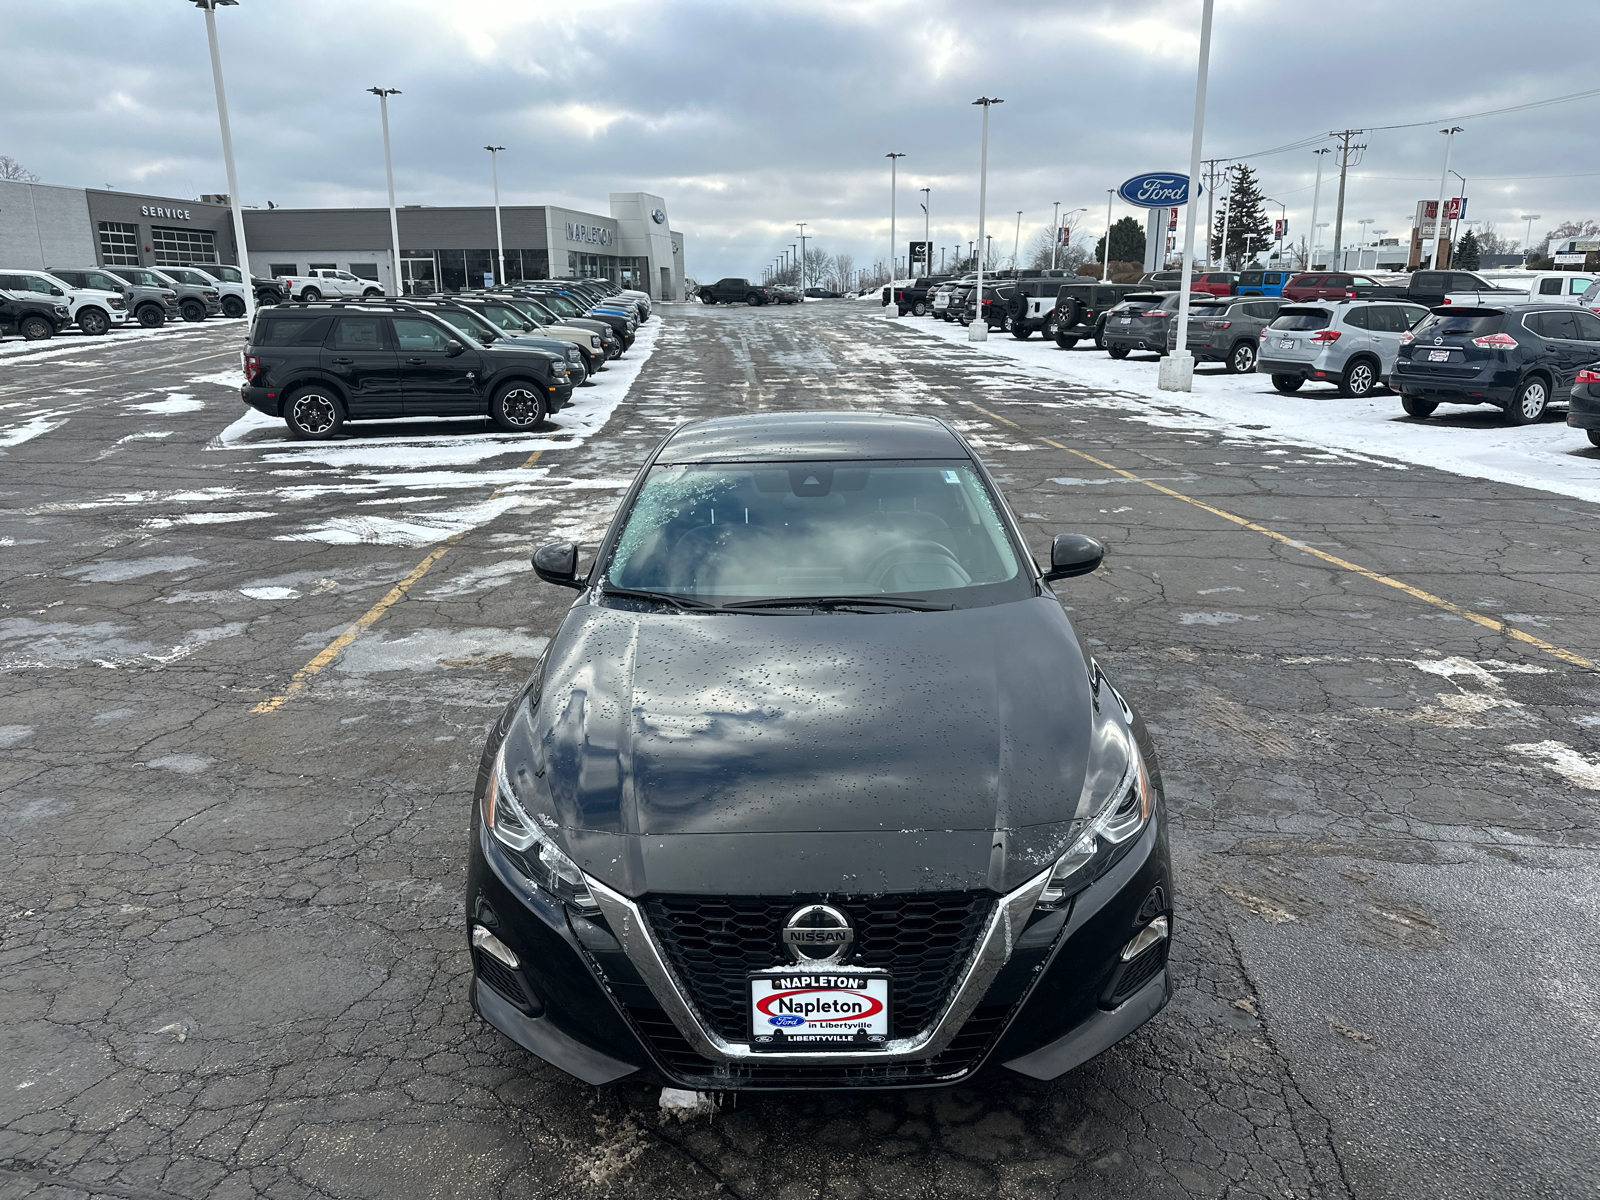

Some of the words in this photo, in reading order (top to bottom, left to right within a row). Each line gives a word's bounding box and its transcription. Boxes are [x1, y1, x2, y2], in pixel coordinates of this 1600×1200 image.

[1137, 178, 1187, 200] Ford
[142, 205, 191, 220] SERVICE
[566, 221, 613, 246] NAPLETON
[790, 931, 846, 941] NISSAN
[780, 976, 859, 988] NAPLETON
[778, 998, 863, 1016] Napleton
[775, 1016, 798, 1026] Ford
[820, 1022, 873, 1031] Libertyville
